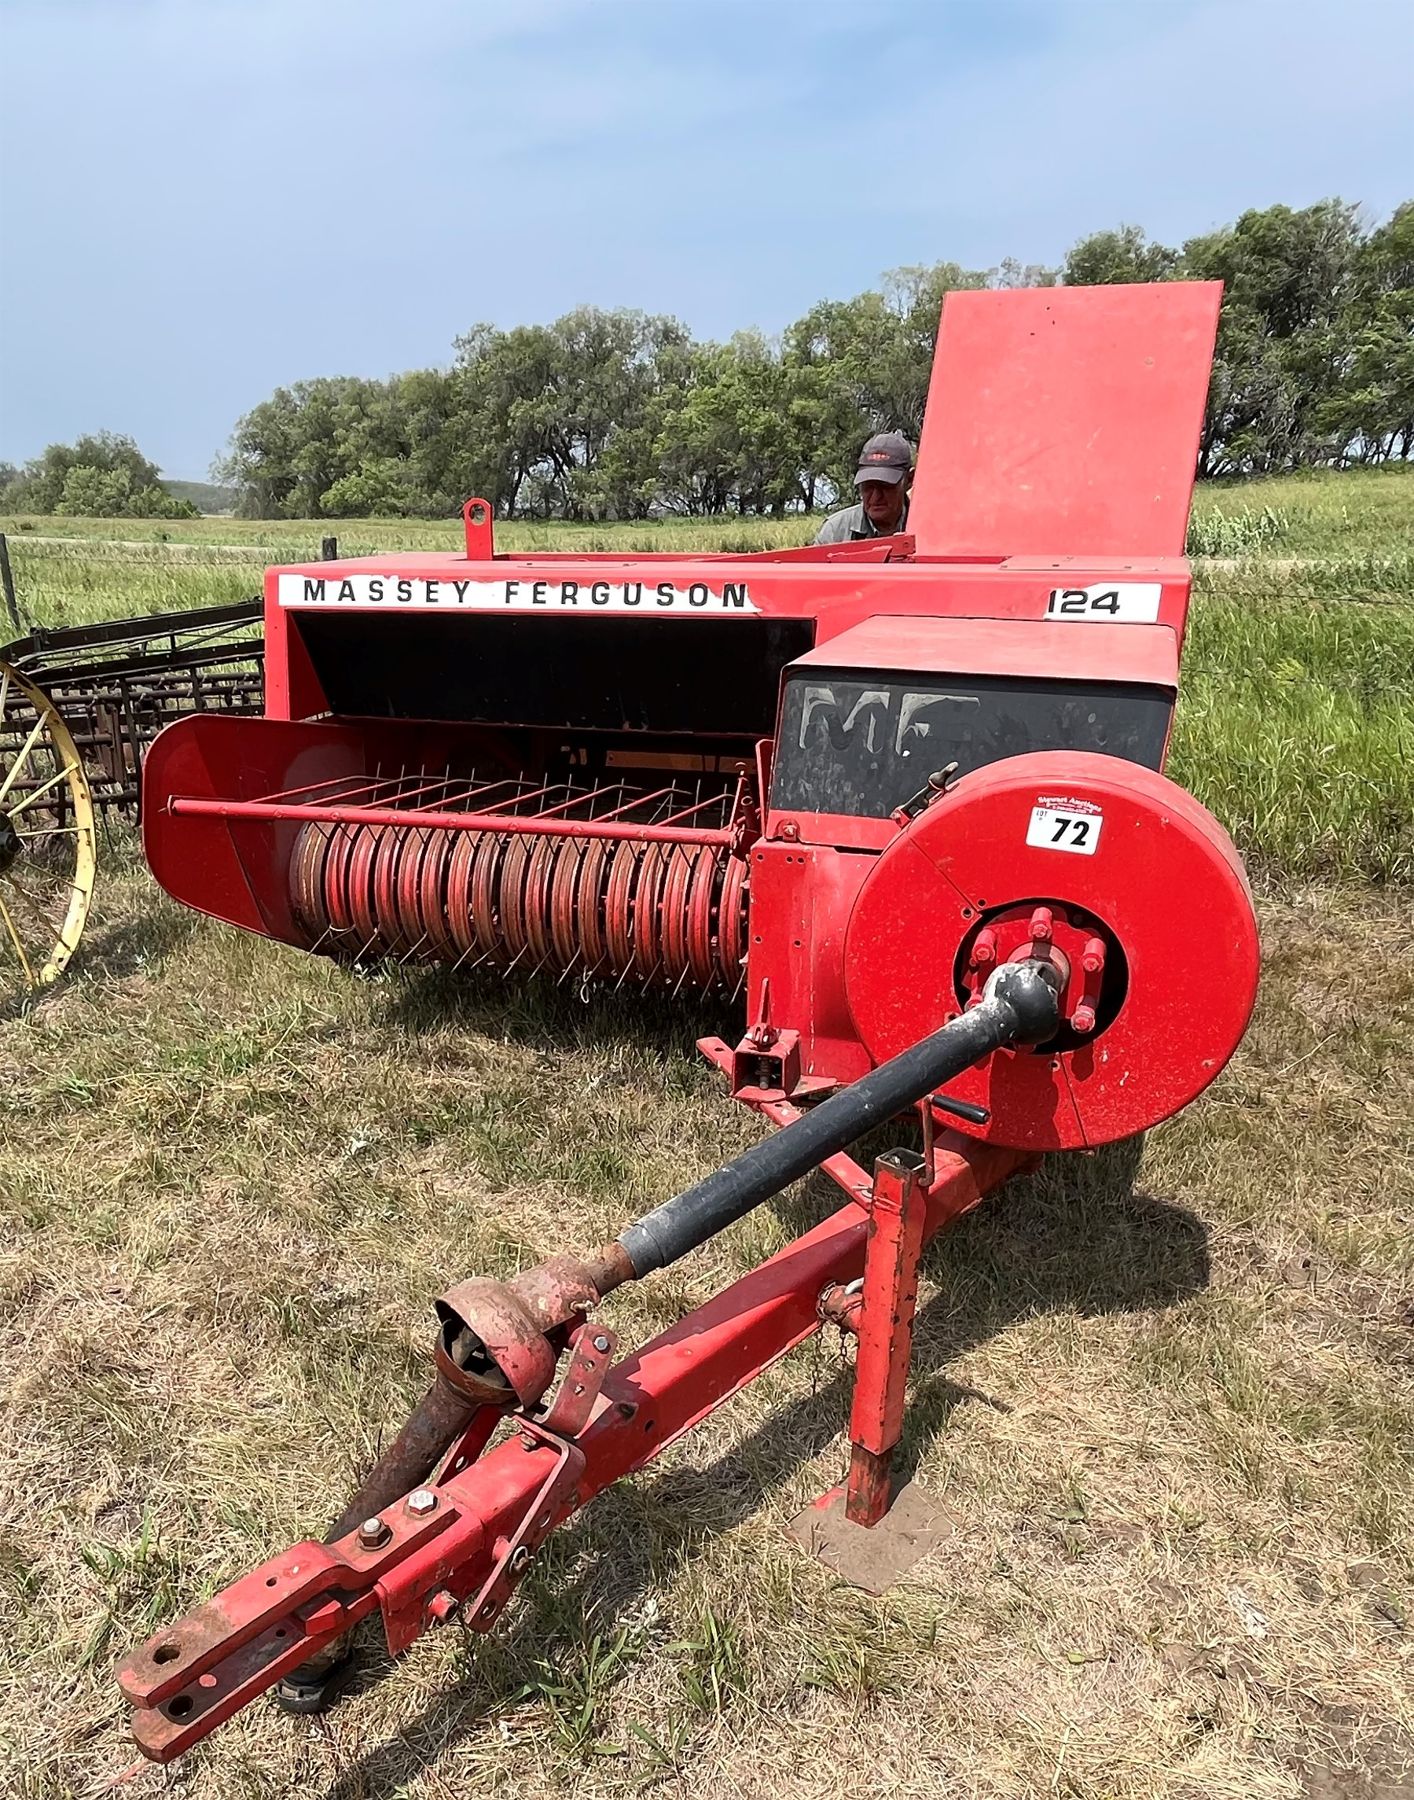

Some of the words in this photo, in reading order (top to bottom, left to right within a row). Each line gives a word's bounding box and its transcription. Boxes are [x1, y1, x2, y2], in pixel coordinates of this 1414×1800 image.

[303, 579, 471, 603] MASSEY
[505, 580, 746, 608] FERGUSON
[1047, 589, 1121, 615] 124
[1036, 809, 1048, 817] LOT
[1050, 817, 1090, 847] 72
